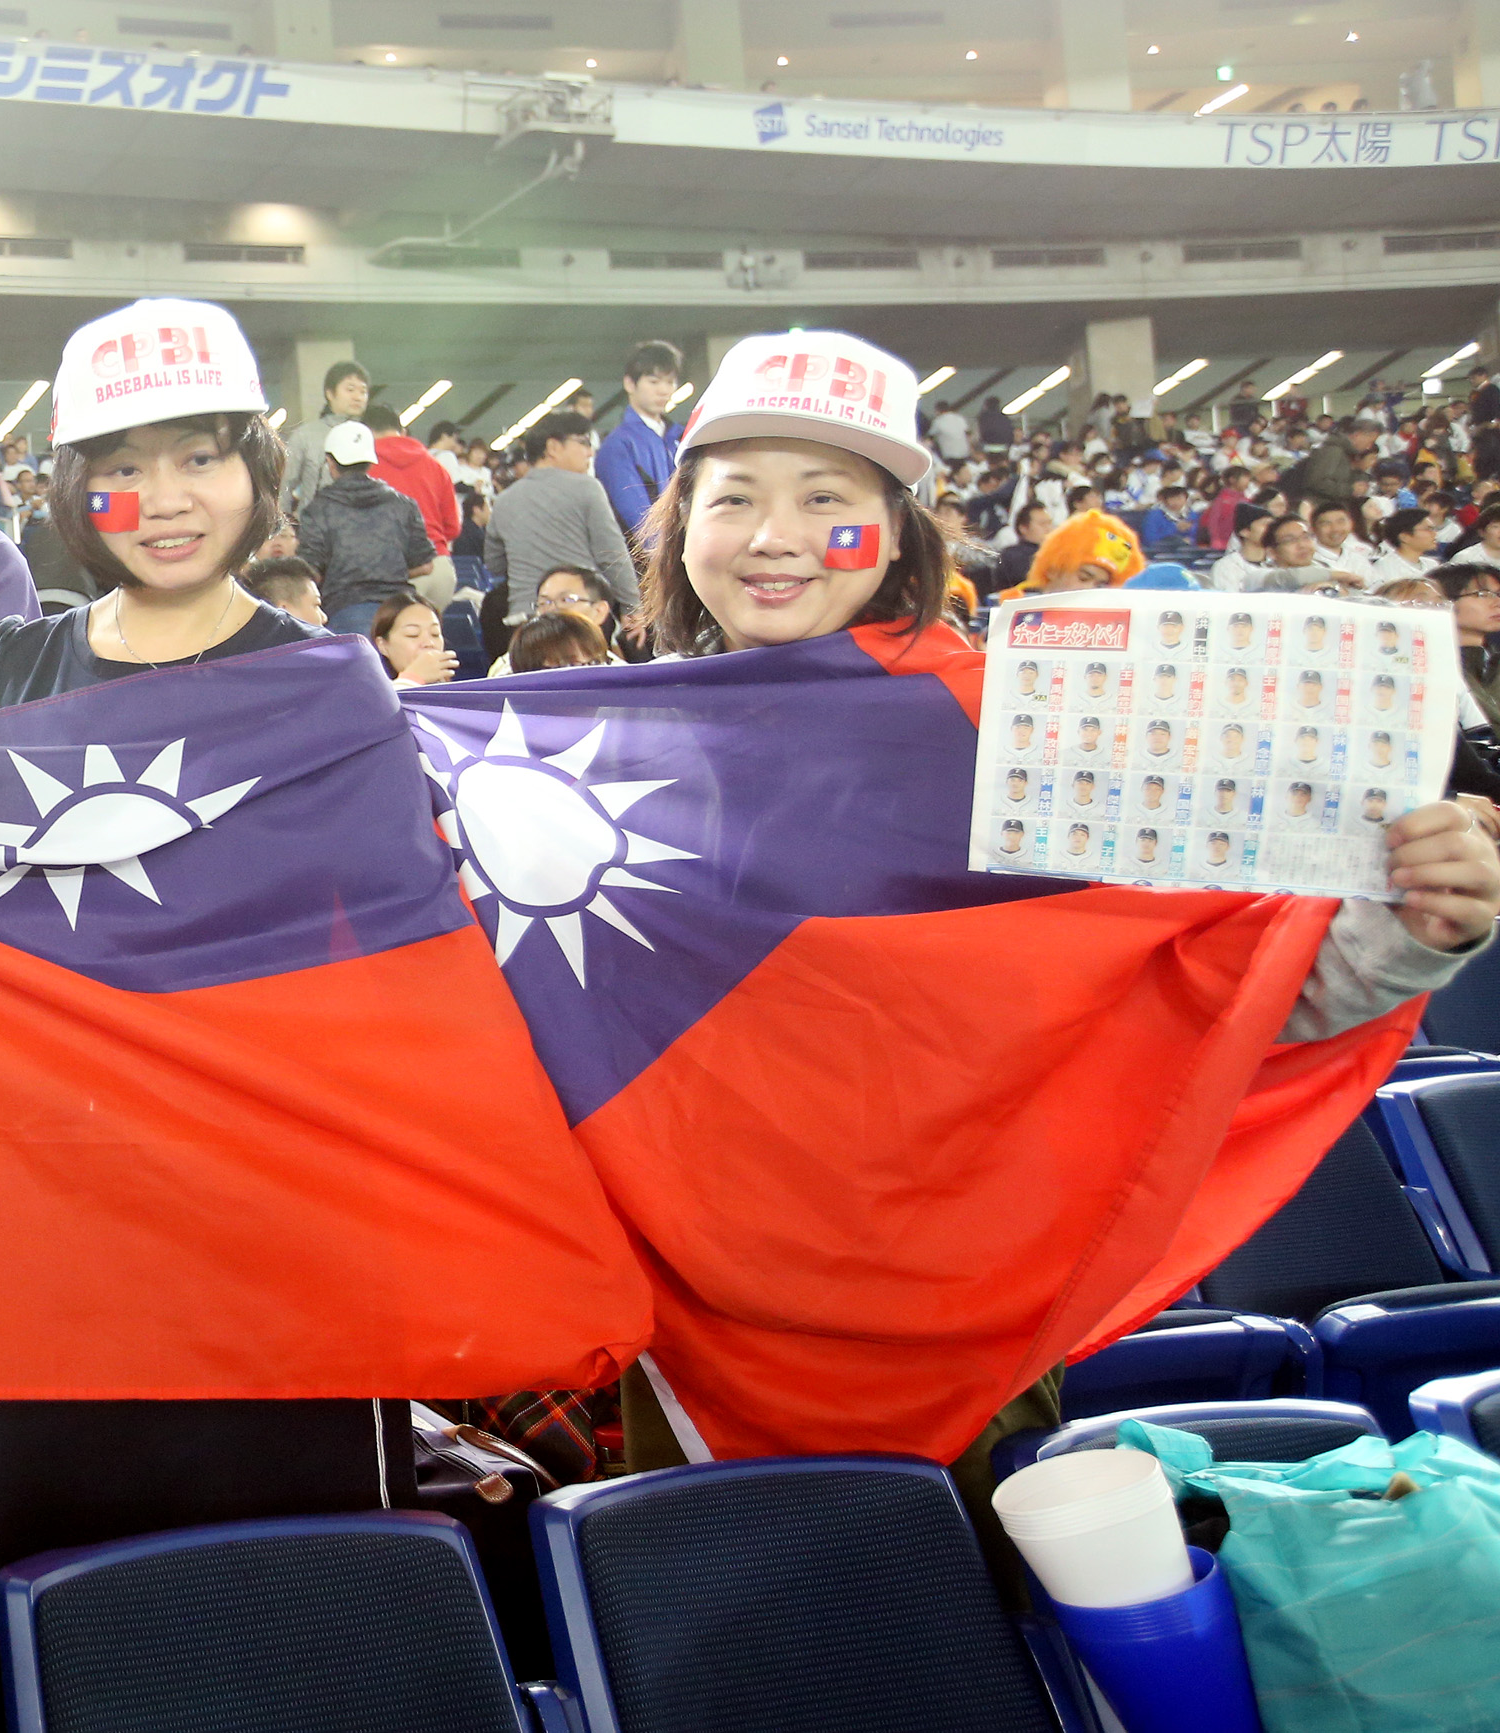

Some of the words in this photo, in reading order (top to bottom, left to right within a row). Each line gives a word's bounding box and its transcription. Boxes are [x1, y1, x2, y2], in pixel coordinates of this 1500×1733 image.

[804, 113, 869, 140] Sansei
[876, 118, 1004, 151] Technologies
[1217, 121, 1392, 166] TSP太陽
[1425, 117, 1500, 163] TS
[91, 326, 221, 379] CPBL
[95, 371, 173, 404] BASEBALL
[177, 369, 191, 386] IS
[196, 369, 223, 387] LIFE
[753, 353, 890, 416] CPBL
